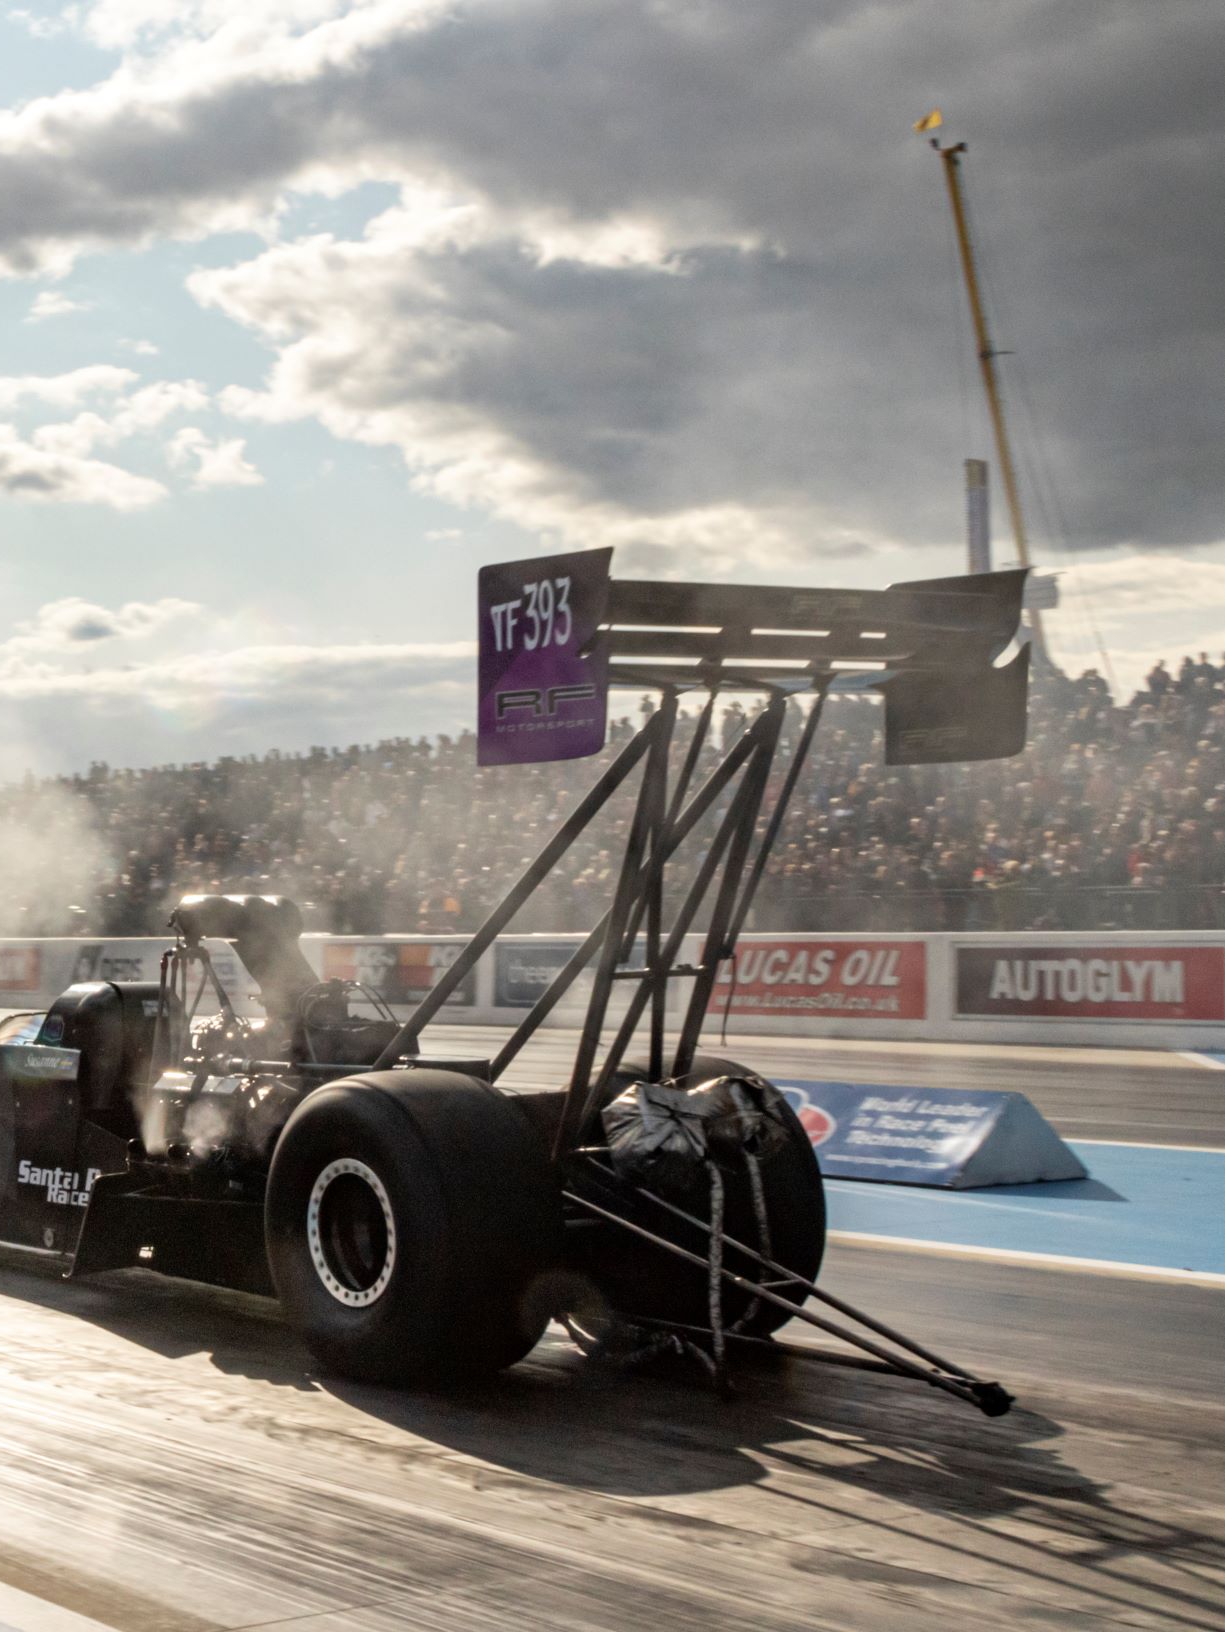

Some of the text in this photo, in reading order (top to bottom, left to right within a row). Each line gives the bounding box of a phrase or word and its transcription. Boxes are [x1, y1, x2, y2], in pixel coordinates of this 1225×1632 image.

[490, 576, 573, 652] TF 393
[496, 718, 596, 733] MOTORSPORT
[716, 948, 901, 986] LUCAS OIL
[989, 958, 1185, 1003] AUTOGLYM
[846, 1130, 949, 1153] Technolog
[17, 1159, 79, 1190] Santa
[46, 1184, 91, 1207] Race
